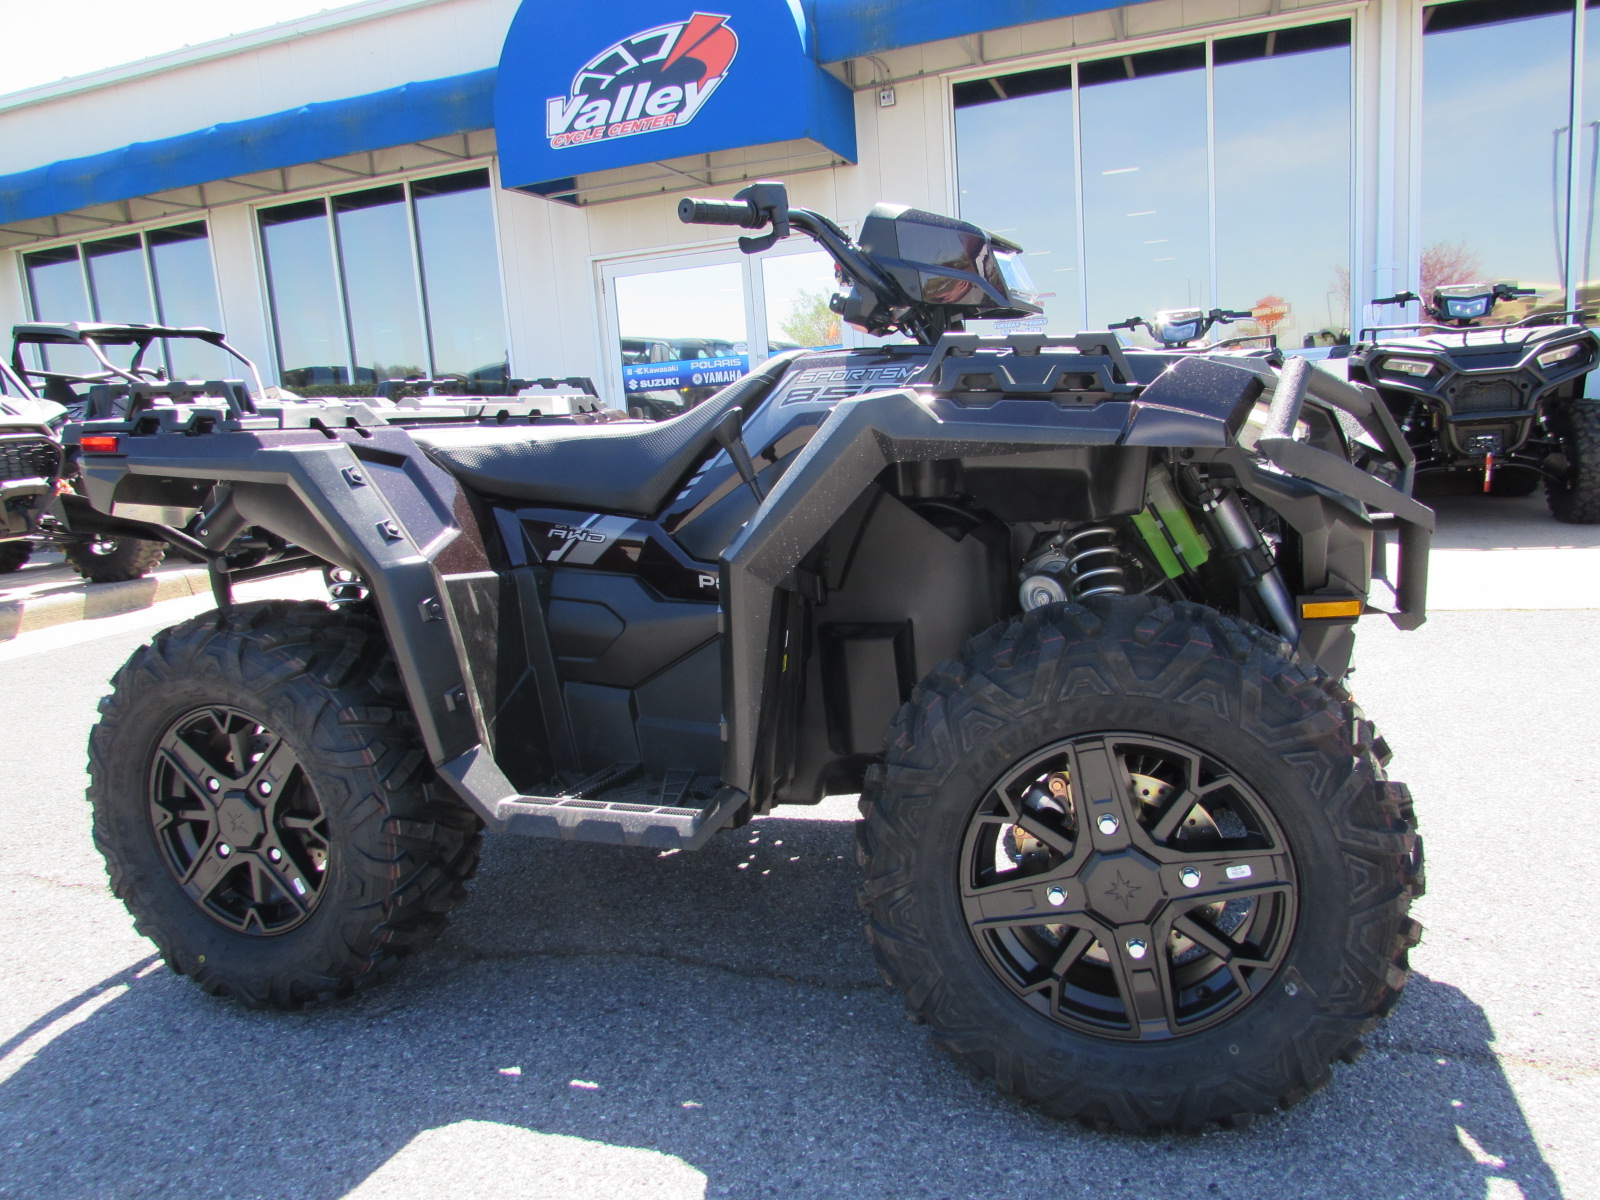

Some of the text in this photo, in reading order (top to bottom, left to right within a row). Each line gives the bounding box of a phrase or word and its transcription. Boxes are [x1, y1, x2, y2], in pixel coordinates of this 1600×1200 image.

[548, 77, 722, 135] Valley
[552, 113, 677, 147] CYCLE CENTER
[643, 364, 679, 374] Kawasaki
[691, 358, 742, 370] POLARIS
[640, 377, 680, 388] SUZUKI
[703, 369, 742, 384] YAMAHA
[547, 528, 607, 543] AWD
